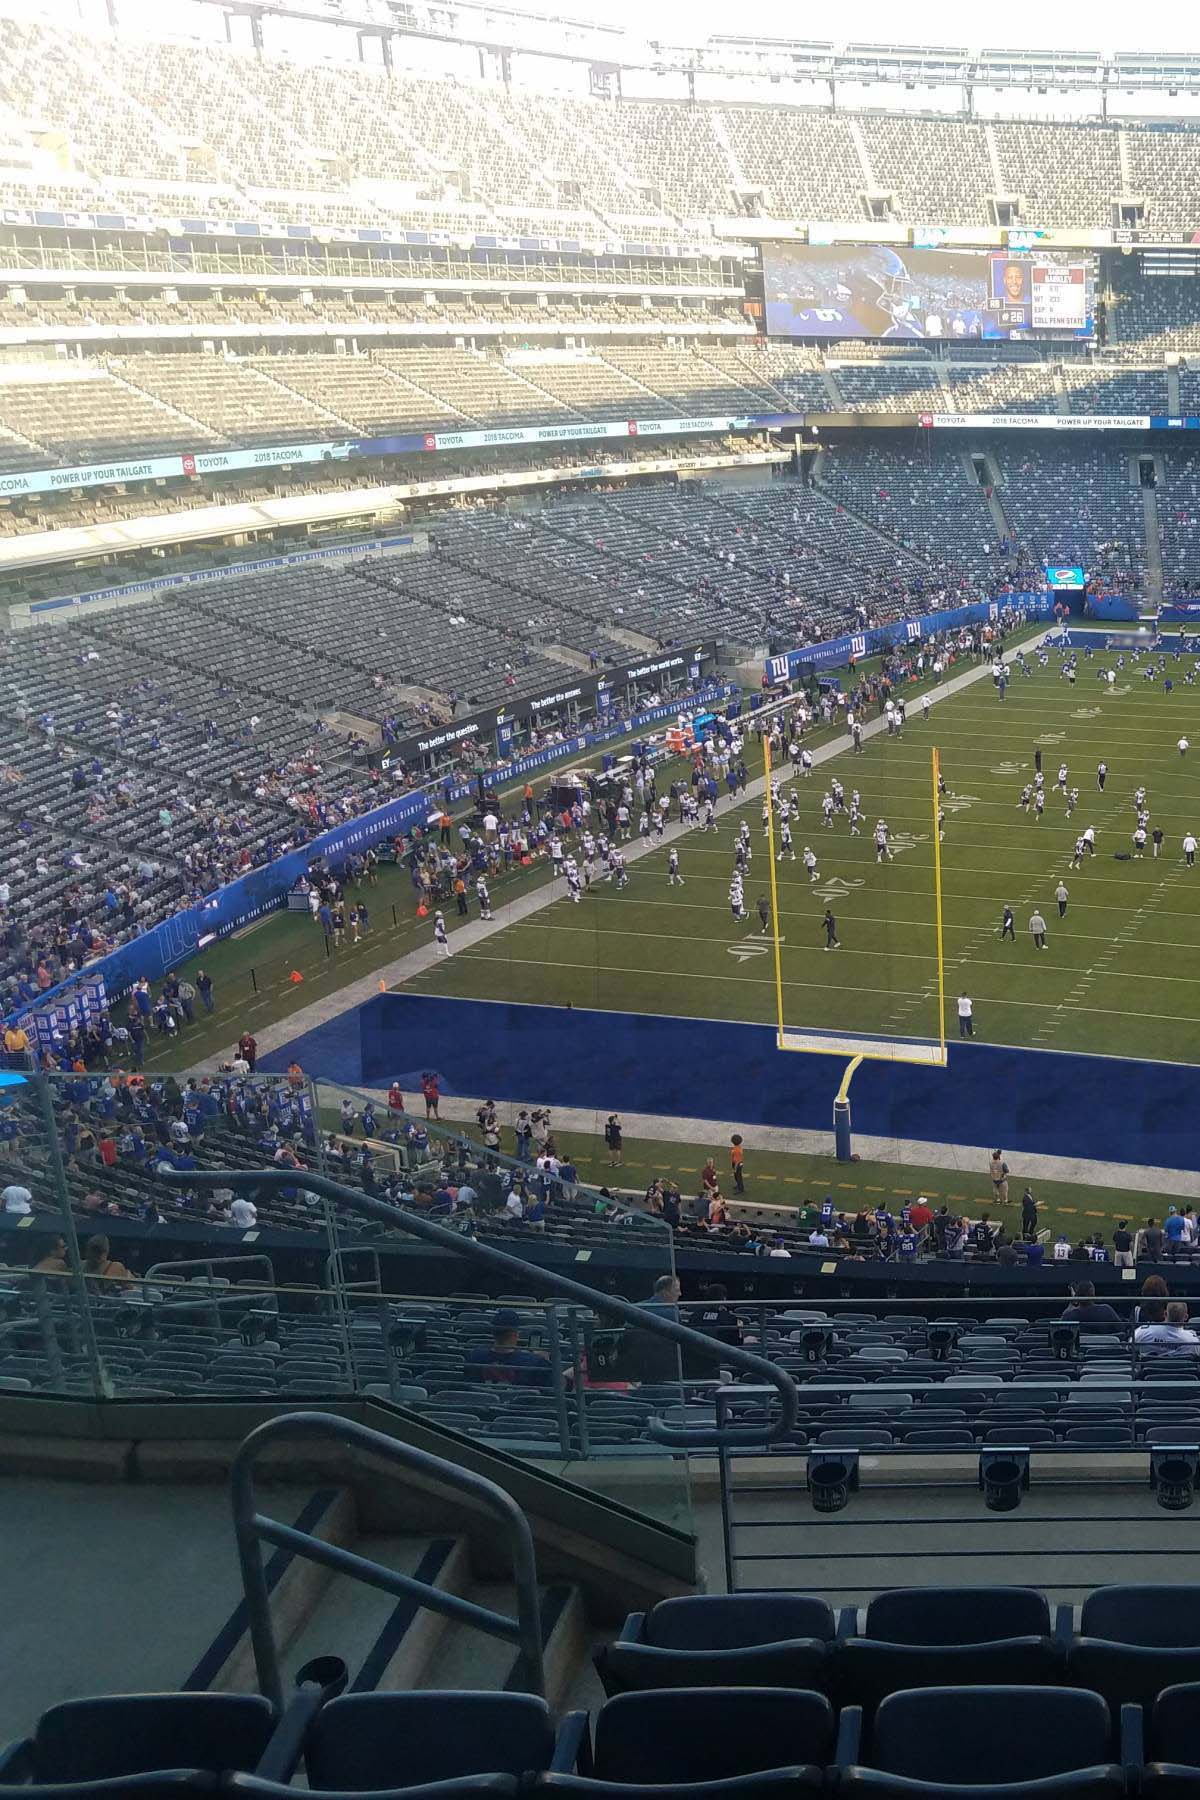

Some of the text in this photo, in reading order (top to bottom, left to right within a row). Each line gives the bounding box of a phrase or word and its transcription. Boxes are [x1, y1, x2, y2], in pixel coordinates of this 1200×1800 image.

[272, 450, 303, 460] TACOMA
[198, 456, 229, 468] TOYOTA
[51, 465, 152, 485] POWER UP YOUR TAILGATE
[0, 478, 29, 491] COMA
[907, 622, 921, 642] ny
[851, 636, 865, 657] ny
[636, 667, 650, 676] better
[650, 664, 658, 672] the
[771, 656, 789, 683] ny
[531, 701, 540, 710] The
[540, 697, 555, 708] better
[497, 715, 504, 724] EY
[418, 724, 479, 751] The better the question.
[381, 759, 391, 769] EY
[516, 755, 545, 774] FOOTBALL
[365, 815, 398, 836] FOOTBALL
[822, 1206, 831, 1215] 13
[808, 1350, 815, 1361] 8
[1060, 1347, 1067, 1359] 6
[598, 1354, 606, 1366] 9
